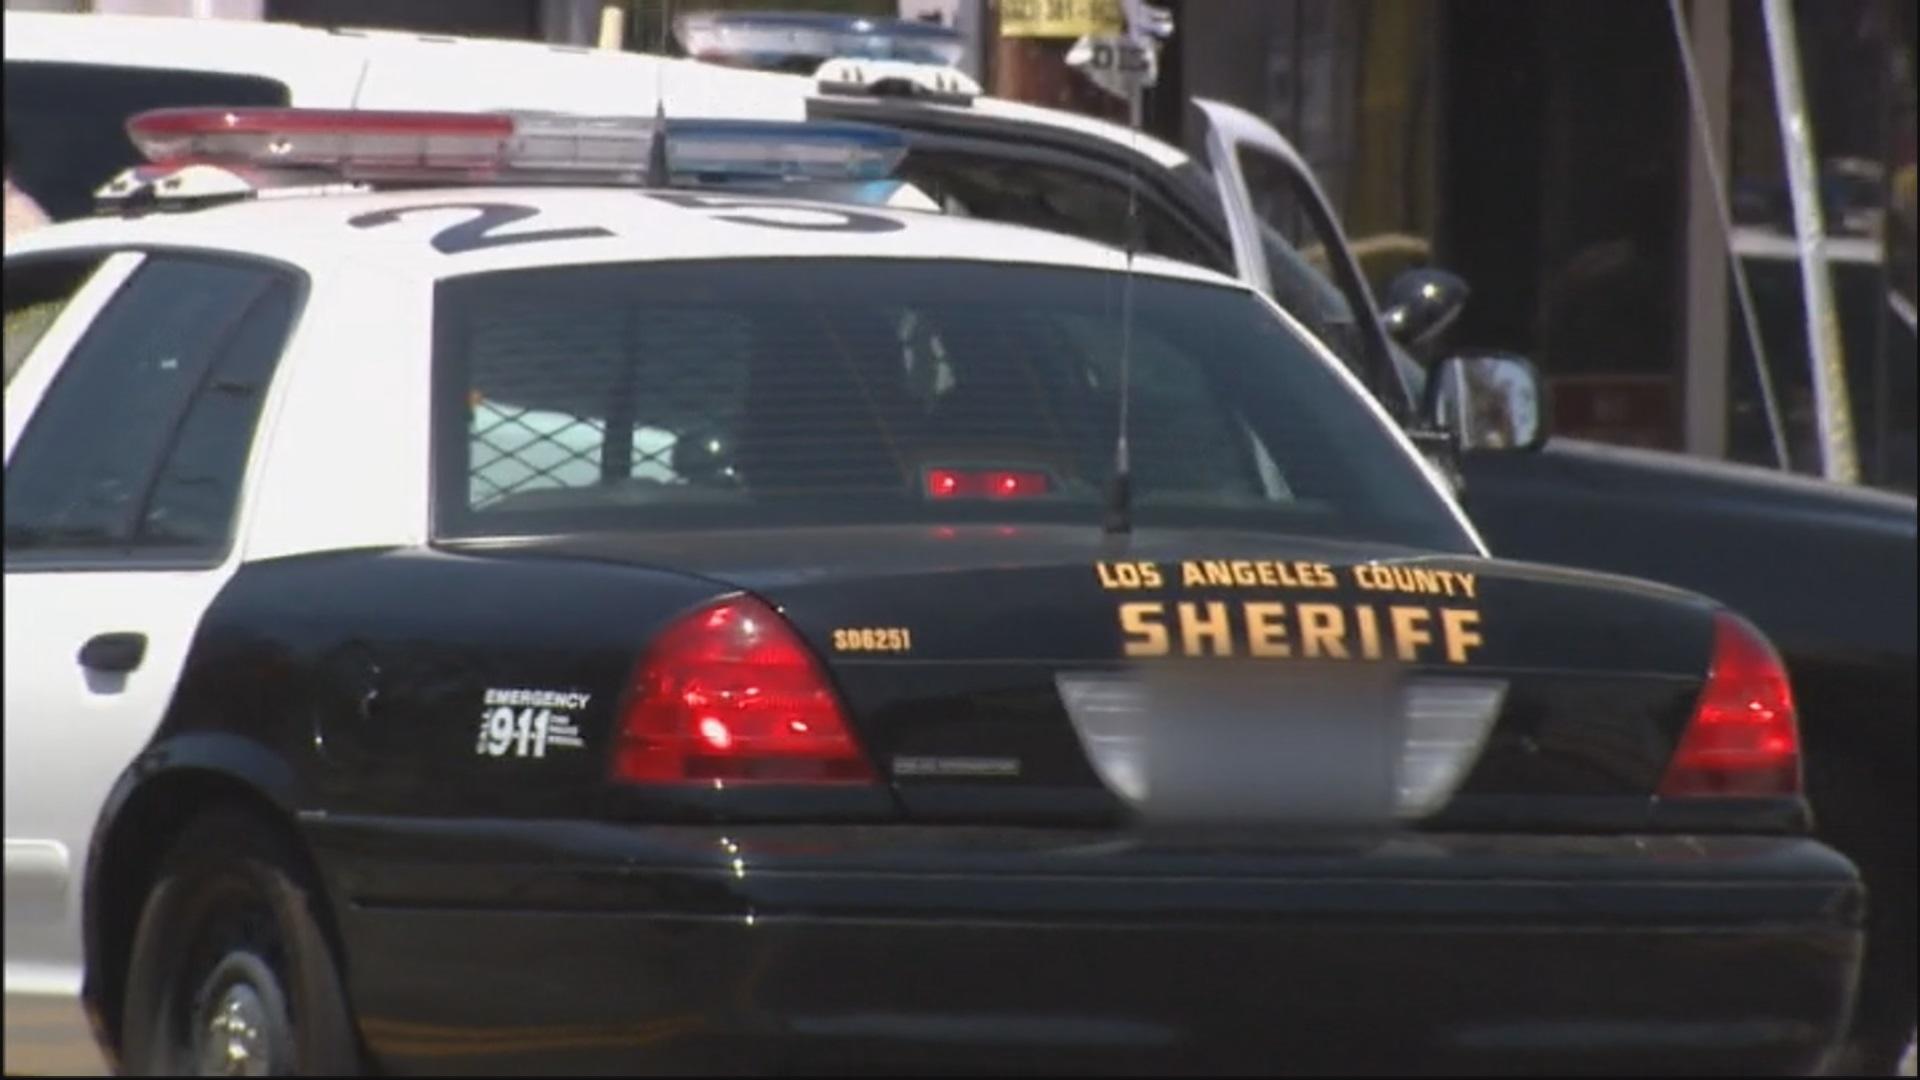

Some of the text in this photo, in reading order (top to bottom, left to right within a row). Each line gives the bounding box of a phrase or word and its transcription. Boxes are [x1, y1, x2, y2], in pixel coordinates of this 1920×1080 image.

[1096, 560, 1477, 598] LOS ANGELES COUNTY
[1119, 601, 1484, 664] SHERIFF
[483, 687, 592, 710] EMERGENCY
